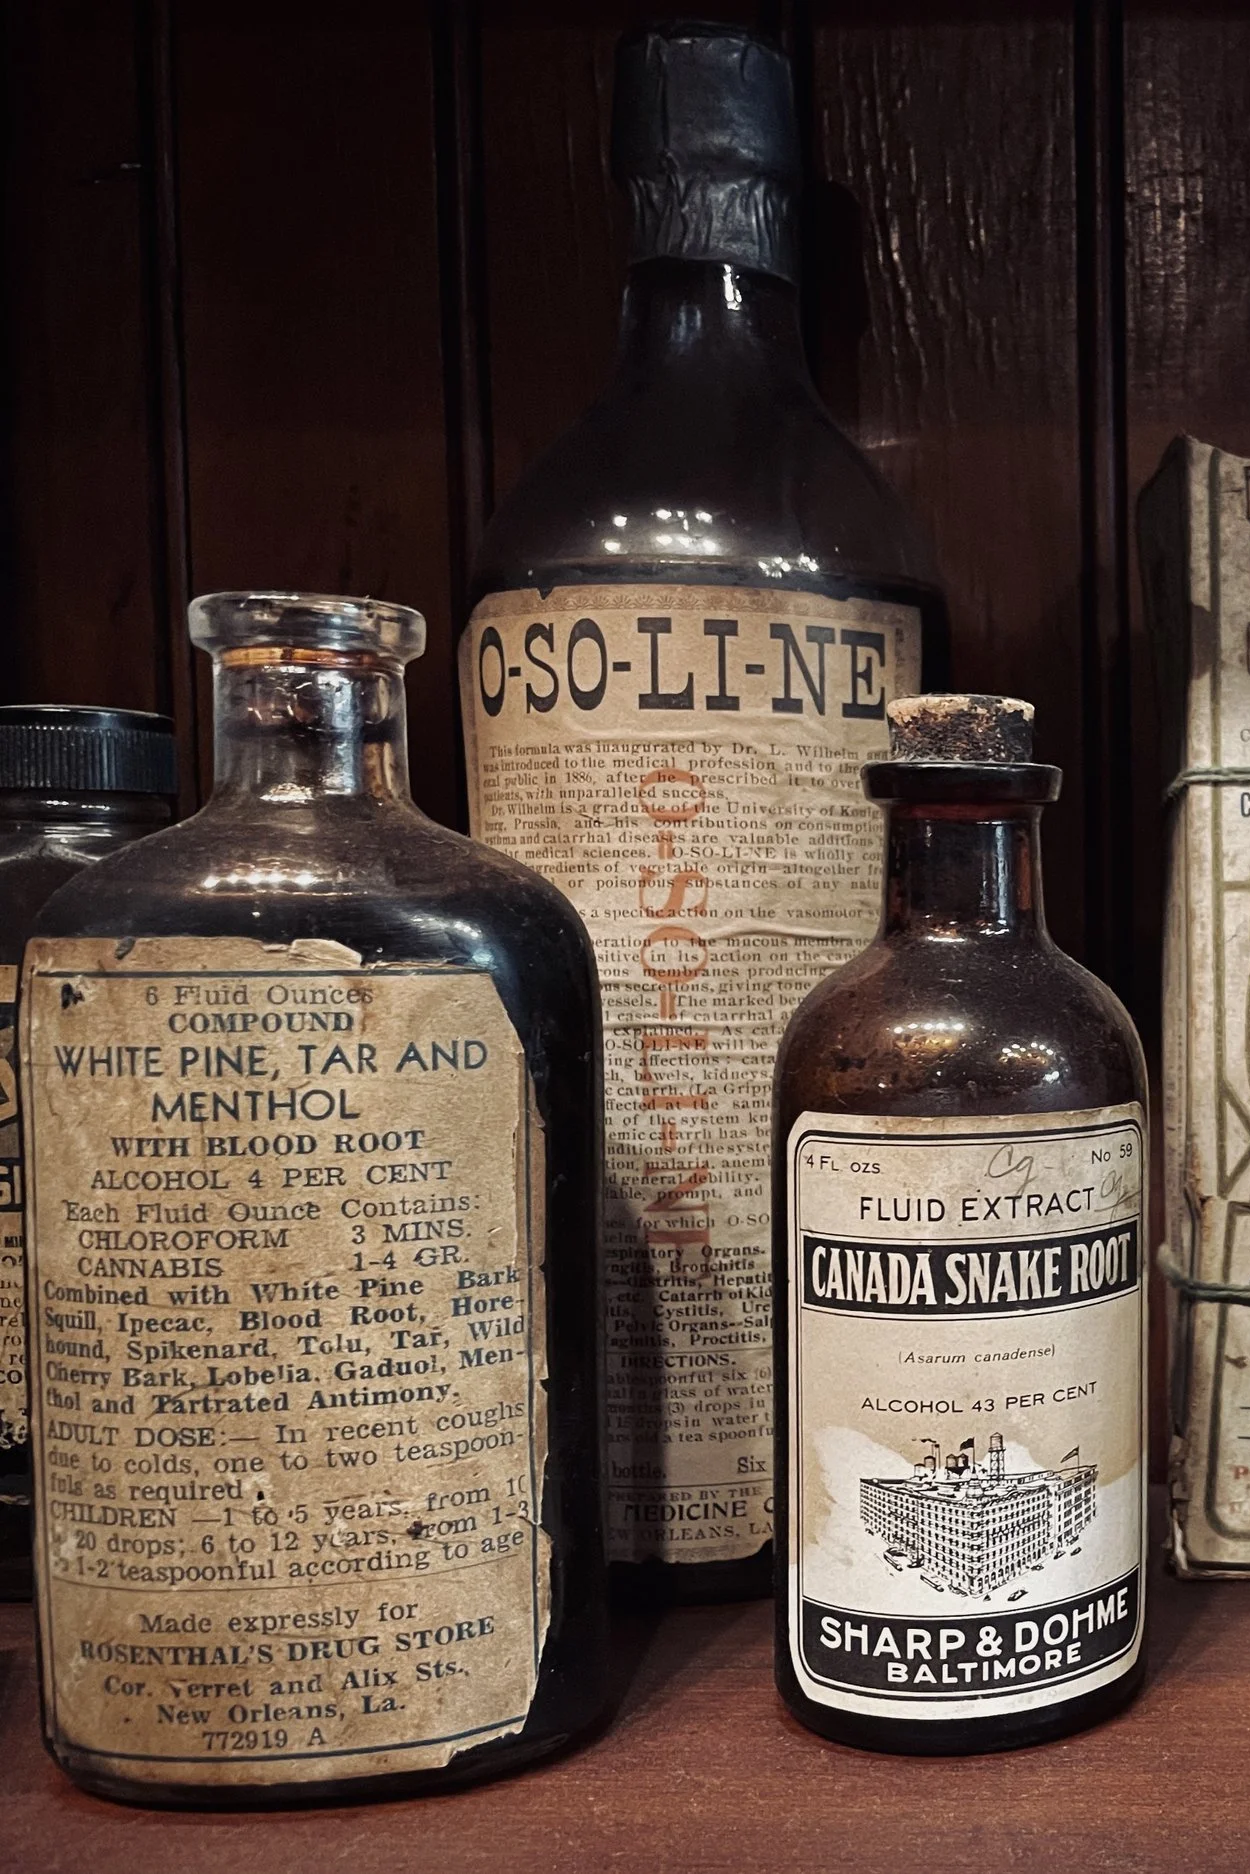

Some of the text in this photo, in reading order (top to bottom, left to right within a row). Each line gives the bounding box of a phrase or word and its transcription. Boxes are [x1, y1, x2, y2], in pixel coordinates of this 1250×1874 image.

[478, 617, 887, 721] O-SO-LI-NE
[564, 744, 592, 754] was
[702, 742, 722, 757] by
[732, 742, 757, 756] Dr.
[796, 745, 859, 761] Wilhelm
[146, 984, 374, 1006] 6 Fluid Ounces
[167, 1011, 353, 1034] COMPOUND
[54, 1040, 488, 1081] WHITE PINE, TAR AND
[151, 1090, 360, 1123] MENTHOL
[112, 1131, 426, 1158] WITH BLOOD ROOT
[806, 1156, 814, 1167] 4
[1119, 1143, 1133, 1158] 59
[91, 1161, 452, 1191] ALCOHOL 4 PER CENT
[63, 1193, 481, 1224] Each Fluid Ounce Contains:
[860, 1197, 945, 1222] FLUID
[961, 1188, 1094, 1222] EXTRACT
[78, 1218, 471, 1251] CHLOROFORM 3 MINS.
[78, 1257, 223, 1279] CANNABIS
[811, 1233, 1130, 1306] CANADA SNAKE ROOT
[899, 1344, 1055, 1365] (Asarum canadense)
[861, 1381, 1097, 1414] ALCOHOL 43 PER CENT
[139, 1600, 419, 1636] Made expressly for
[819, 1587, 1128, 1660] SHARP & DOHME
[80, 1616, 495, 1666] ROSENTHAL'S DRUG STORE
[887, 1641, 1082, 1684] BALTIMORE
[104, 1667, 397, 1697] Cor. and Alix
[157, 1695, 405, 1726] New Orleans, La.
[203, 1726, 326, 1751] 772919 A
